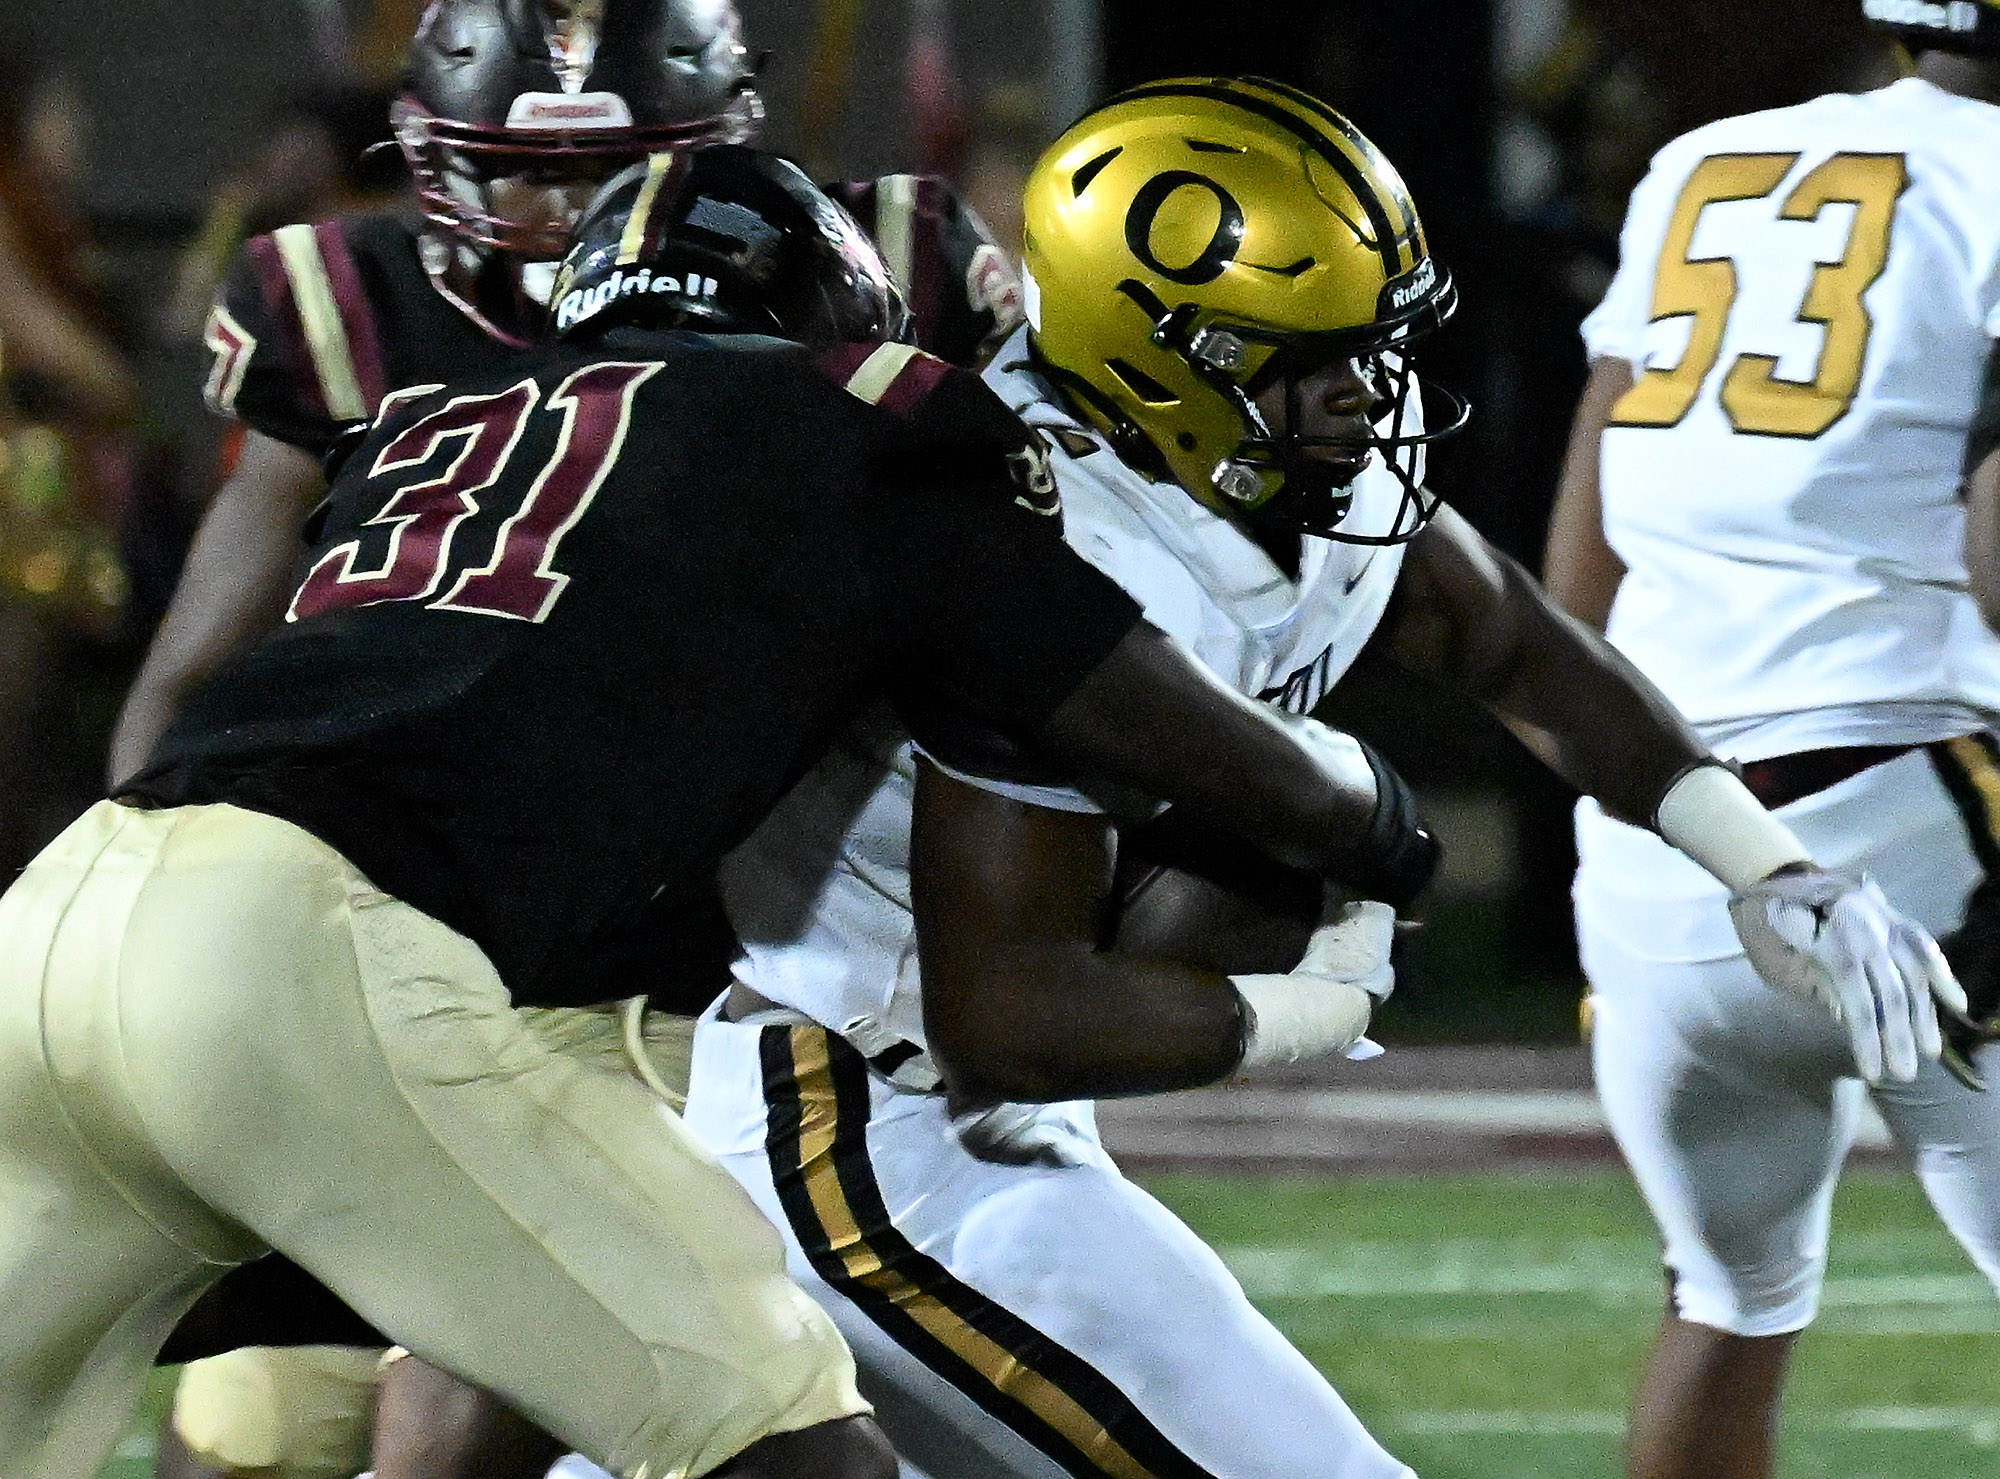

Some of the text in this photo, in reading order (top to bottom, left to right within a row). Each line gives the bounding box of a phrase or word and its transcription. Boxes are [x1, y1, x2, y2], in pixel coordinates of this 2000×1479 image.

[1125, 170, 1246, 286] O
[1605, 151, 1914, 440] 53
[285, 361, 667, 623] 31
